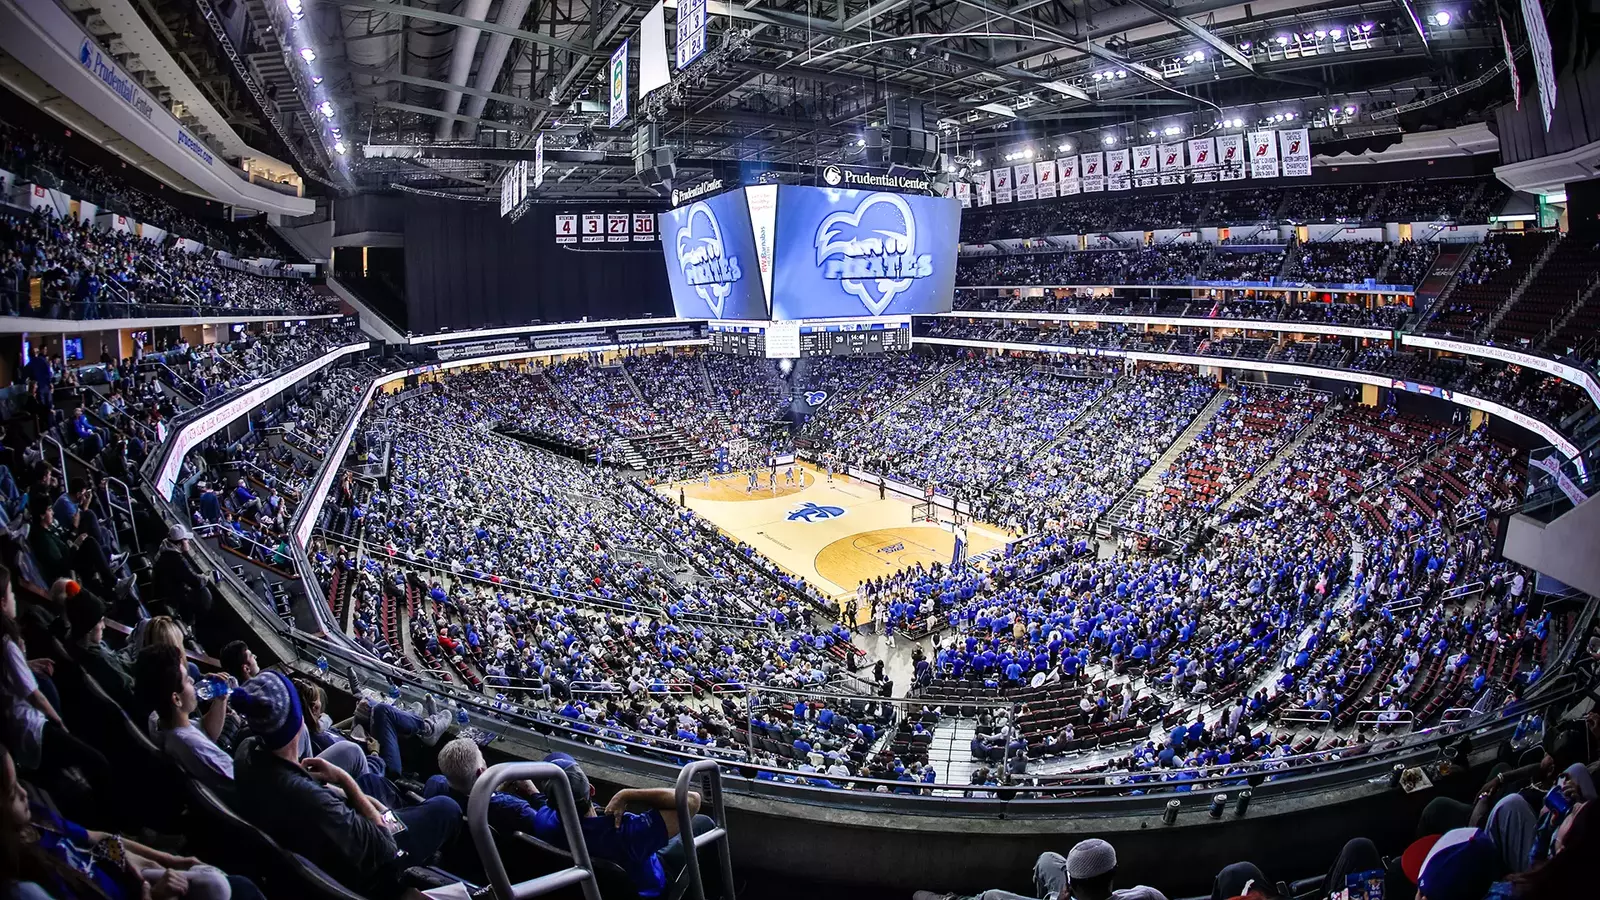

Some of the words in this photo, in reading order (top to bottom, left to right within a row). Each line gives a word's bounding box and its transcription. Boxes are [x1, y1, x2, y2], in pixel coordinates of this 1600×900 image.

[680, 2, 688, 19] 12
[694, 14, 700, 29] 3
[679, 24, 688, 42] 34
[691, 35, 701, 55] 24
[681, 49, 686, 63] 8
[93, 52, 133, 103] Prudential
[132, 88, 153, 120] Center
[177, 129, 213, 166] prucenter.com
[845, 170, 898, 186] Prudential
[899, 176, 930, 190] Center
[679, 183, 704, 202] Prudential
[703, 179, 724, 193] Center
[562, 220, 571, 234] 4
[588, 219, 597, 233] 3
[610, 219, 627, 233] 27
[635, 218, 653, 232] 30
